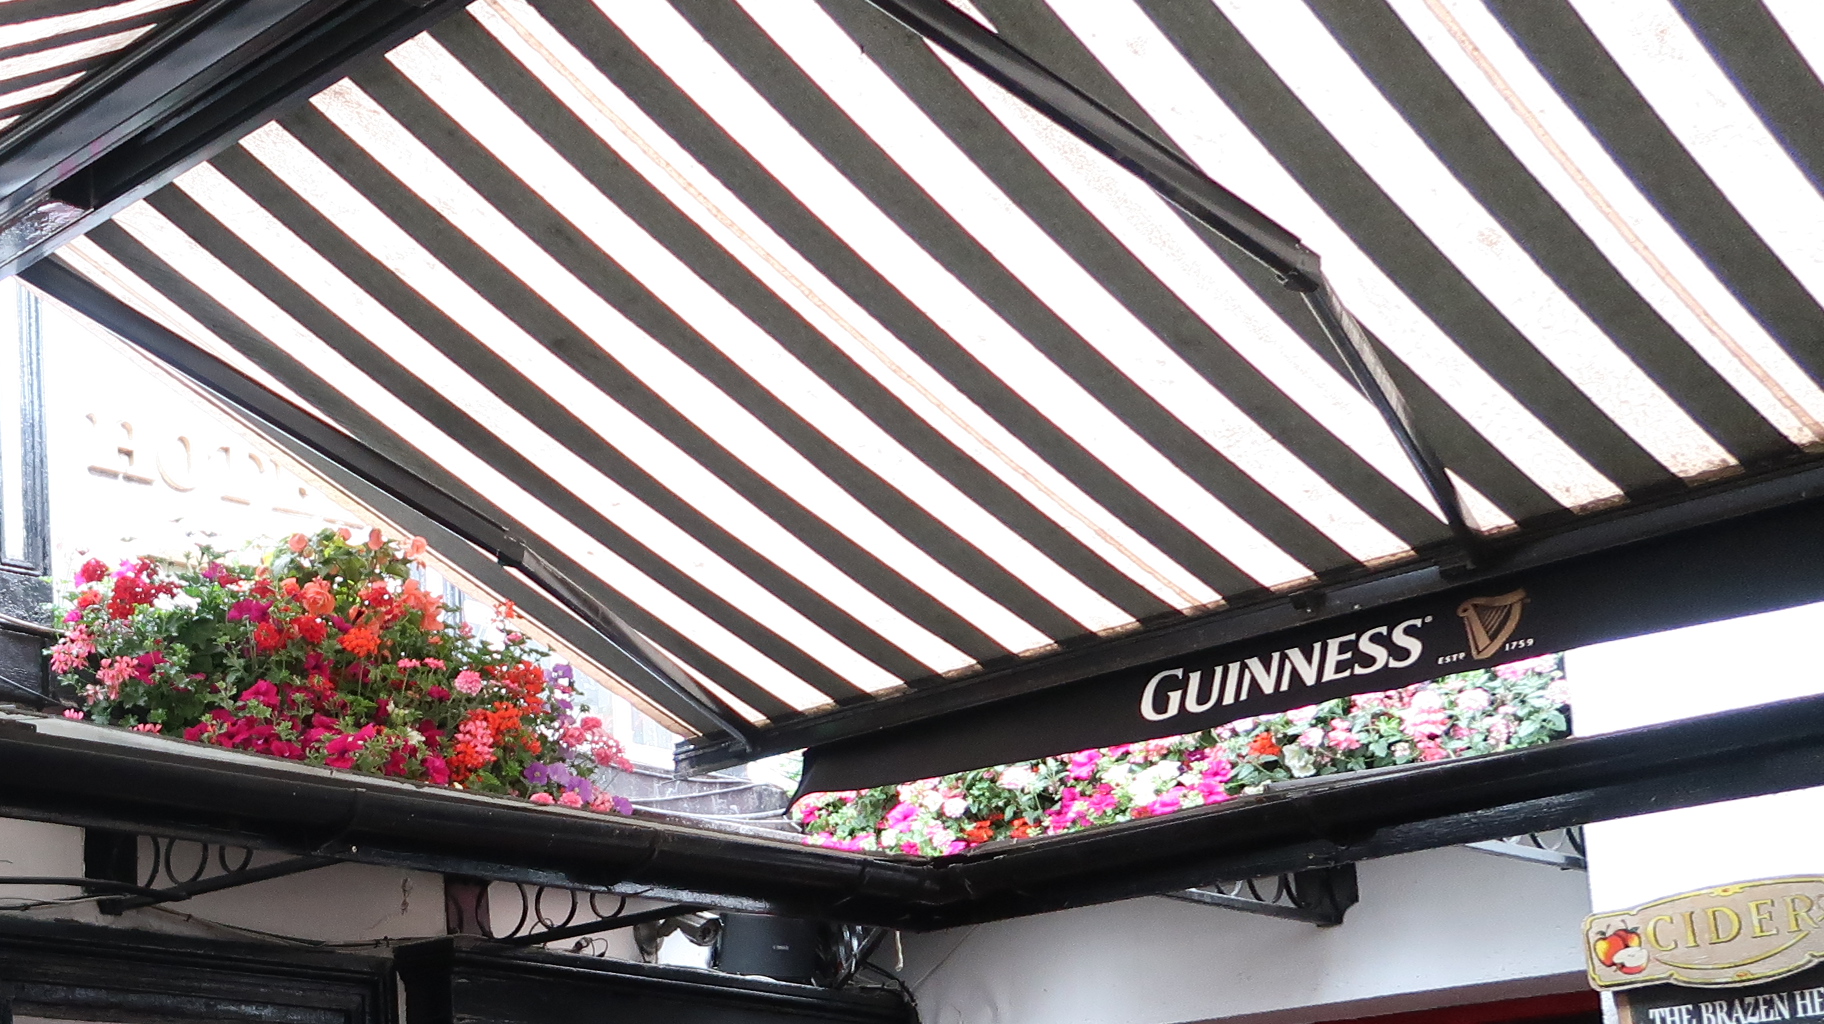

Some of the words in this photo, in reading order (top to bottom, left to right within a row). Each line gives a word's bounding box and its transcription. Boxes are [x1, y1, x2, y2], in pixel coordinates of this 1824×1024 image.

[1504, 637, 1535, 652] 1759
[1139, 616, 1426, 722] GUINNESS
[1794, 986, 1824, 1018] HE
